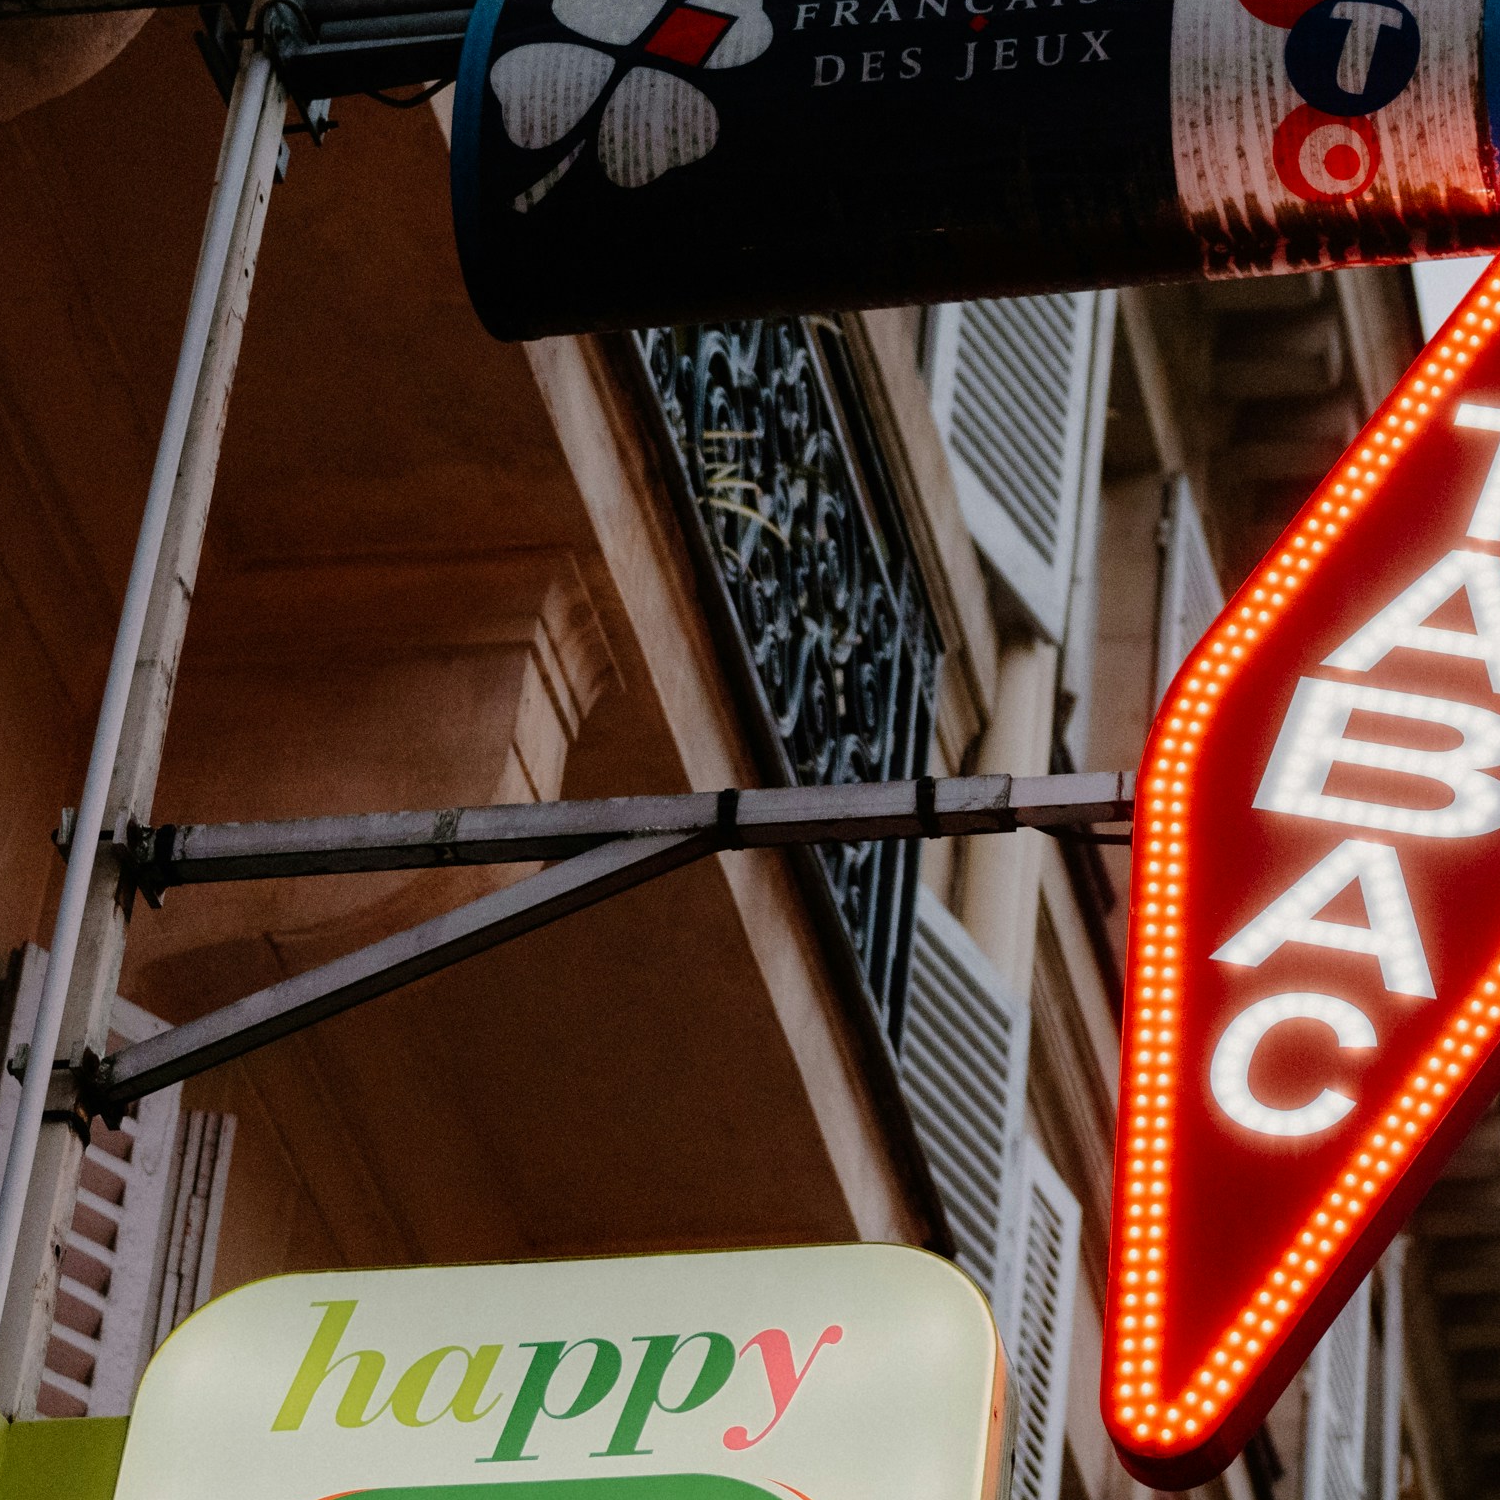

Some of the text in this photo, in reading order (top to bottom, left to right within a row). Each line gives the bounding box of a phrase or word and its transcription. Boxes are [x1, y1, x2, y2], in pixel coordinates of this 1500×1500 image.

[810, 28, 1115, 88] DES JEUX
[270, 1298, 844, 1464] happy
